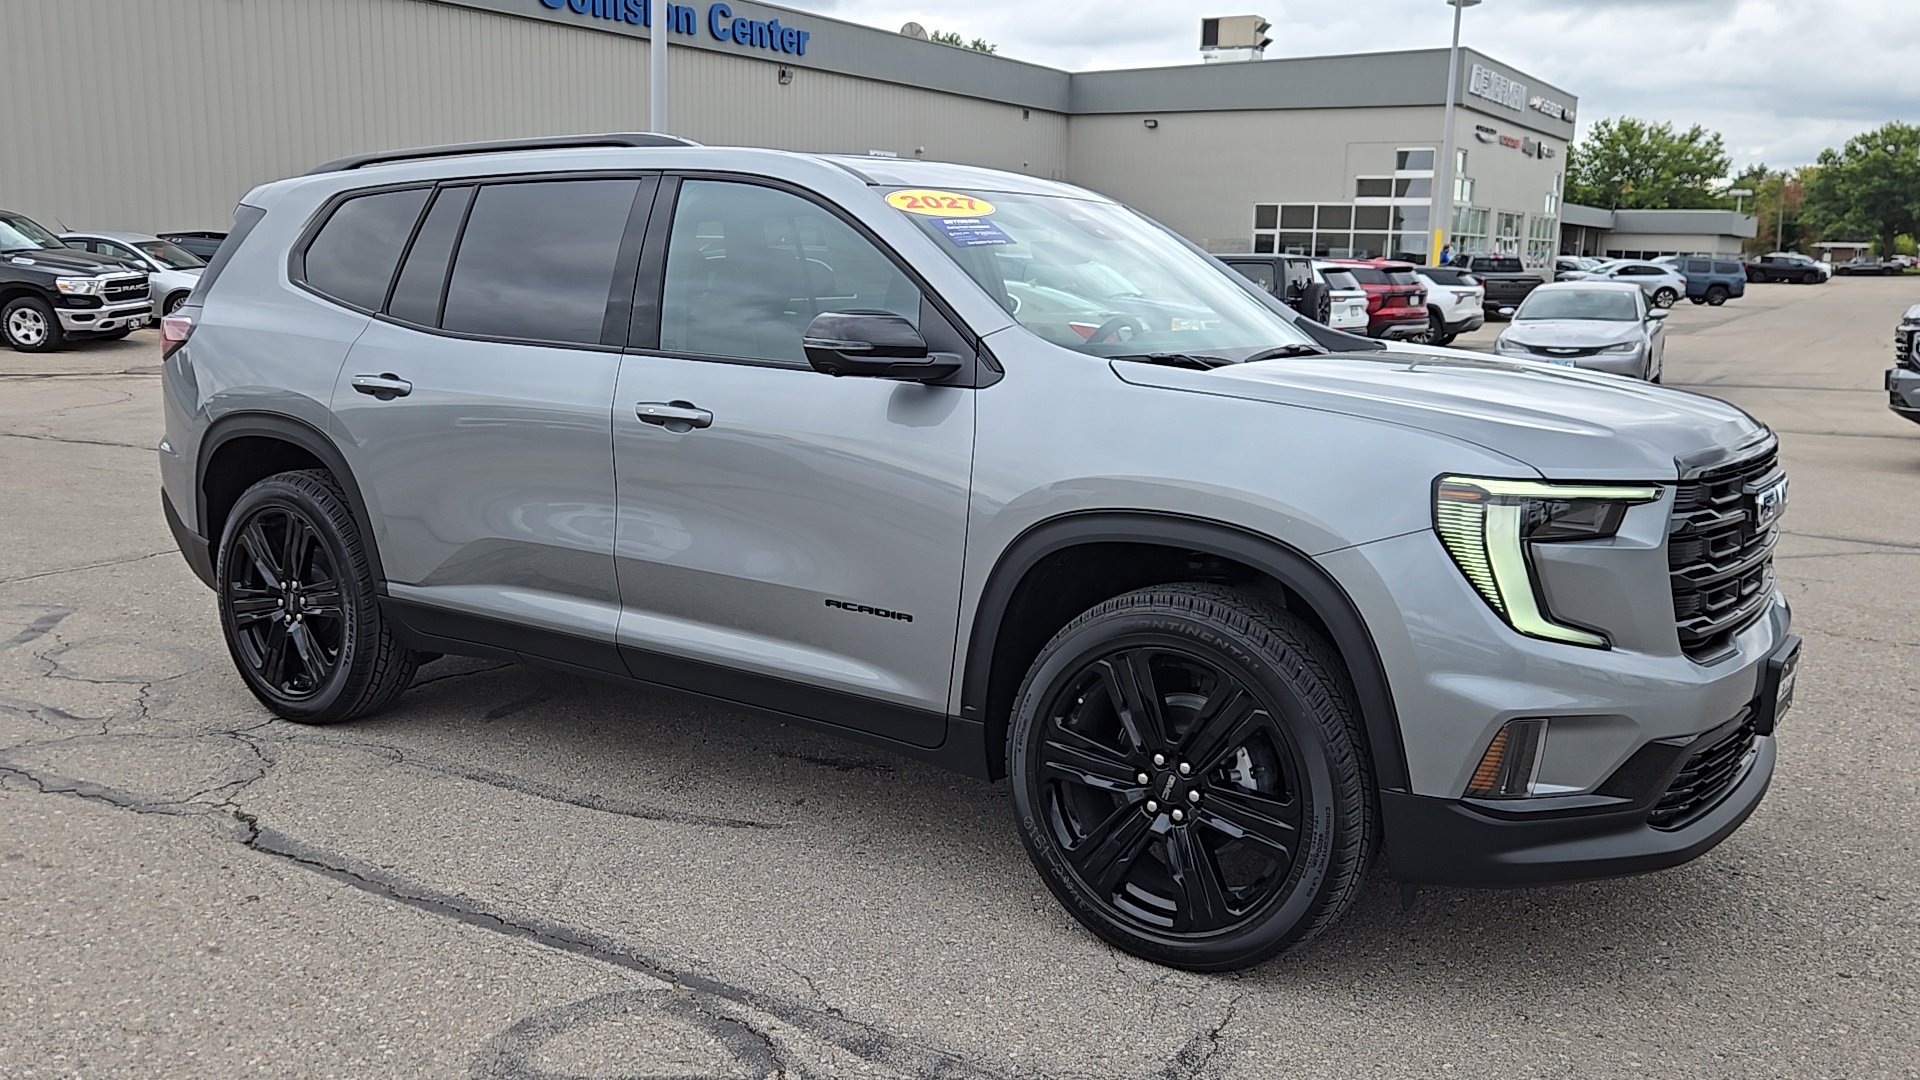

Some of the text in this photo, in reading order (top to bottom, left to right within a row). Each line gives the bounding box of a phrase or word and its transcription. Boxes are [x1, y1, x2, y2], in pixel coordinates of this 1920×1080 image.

[540, 0, 810, 55] ollision Center
[900, 195, 978, 211] 2027
[343, 588, 354, 668] NTINENTAL
[824, 598, 914, 623] ACADIA
[1121, 619, 1260, 671] CONTINENTAL
